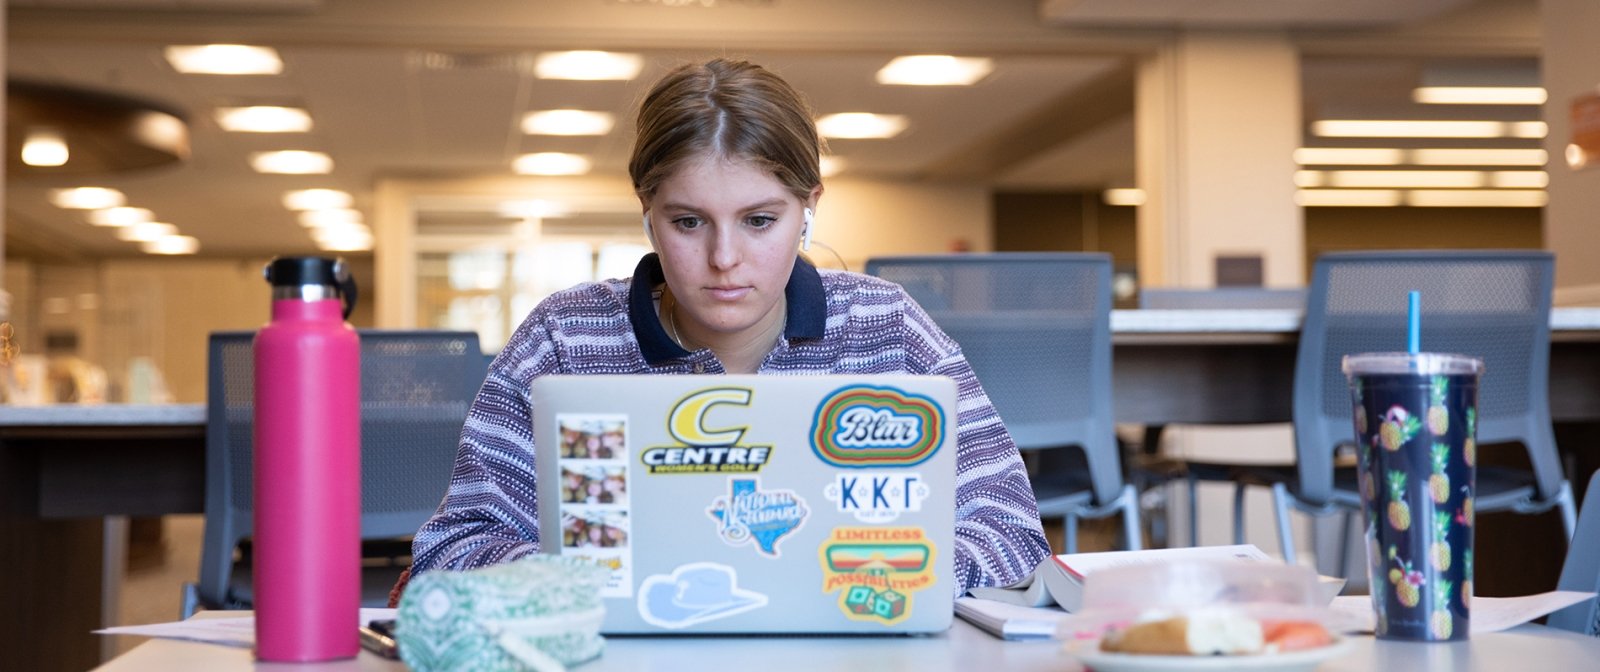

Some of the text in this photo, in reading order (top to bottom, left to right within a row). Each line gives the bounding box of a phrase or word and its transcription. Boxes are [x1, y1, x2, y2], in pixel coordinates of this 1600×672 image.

[842, 411, 912, 441] Blur
[642, 447, 770, 465] CENTRE
[655, 464, 757, 473] WOMEN'S GOLF
[836, 529, 922, 540] LIMITLESS
